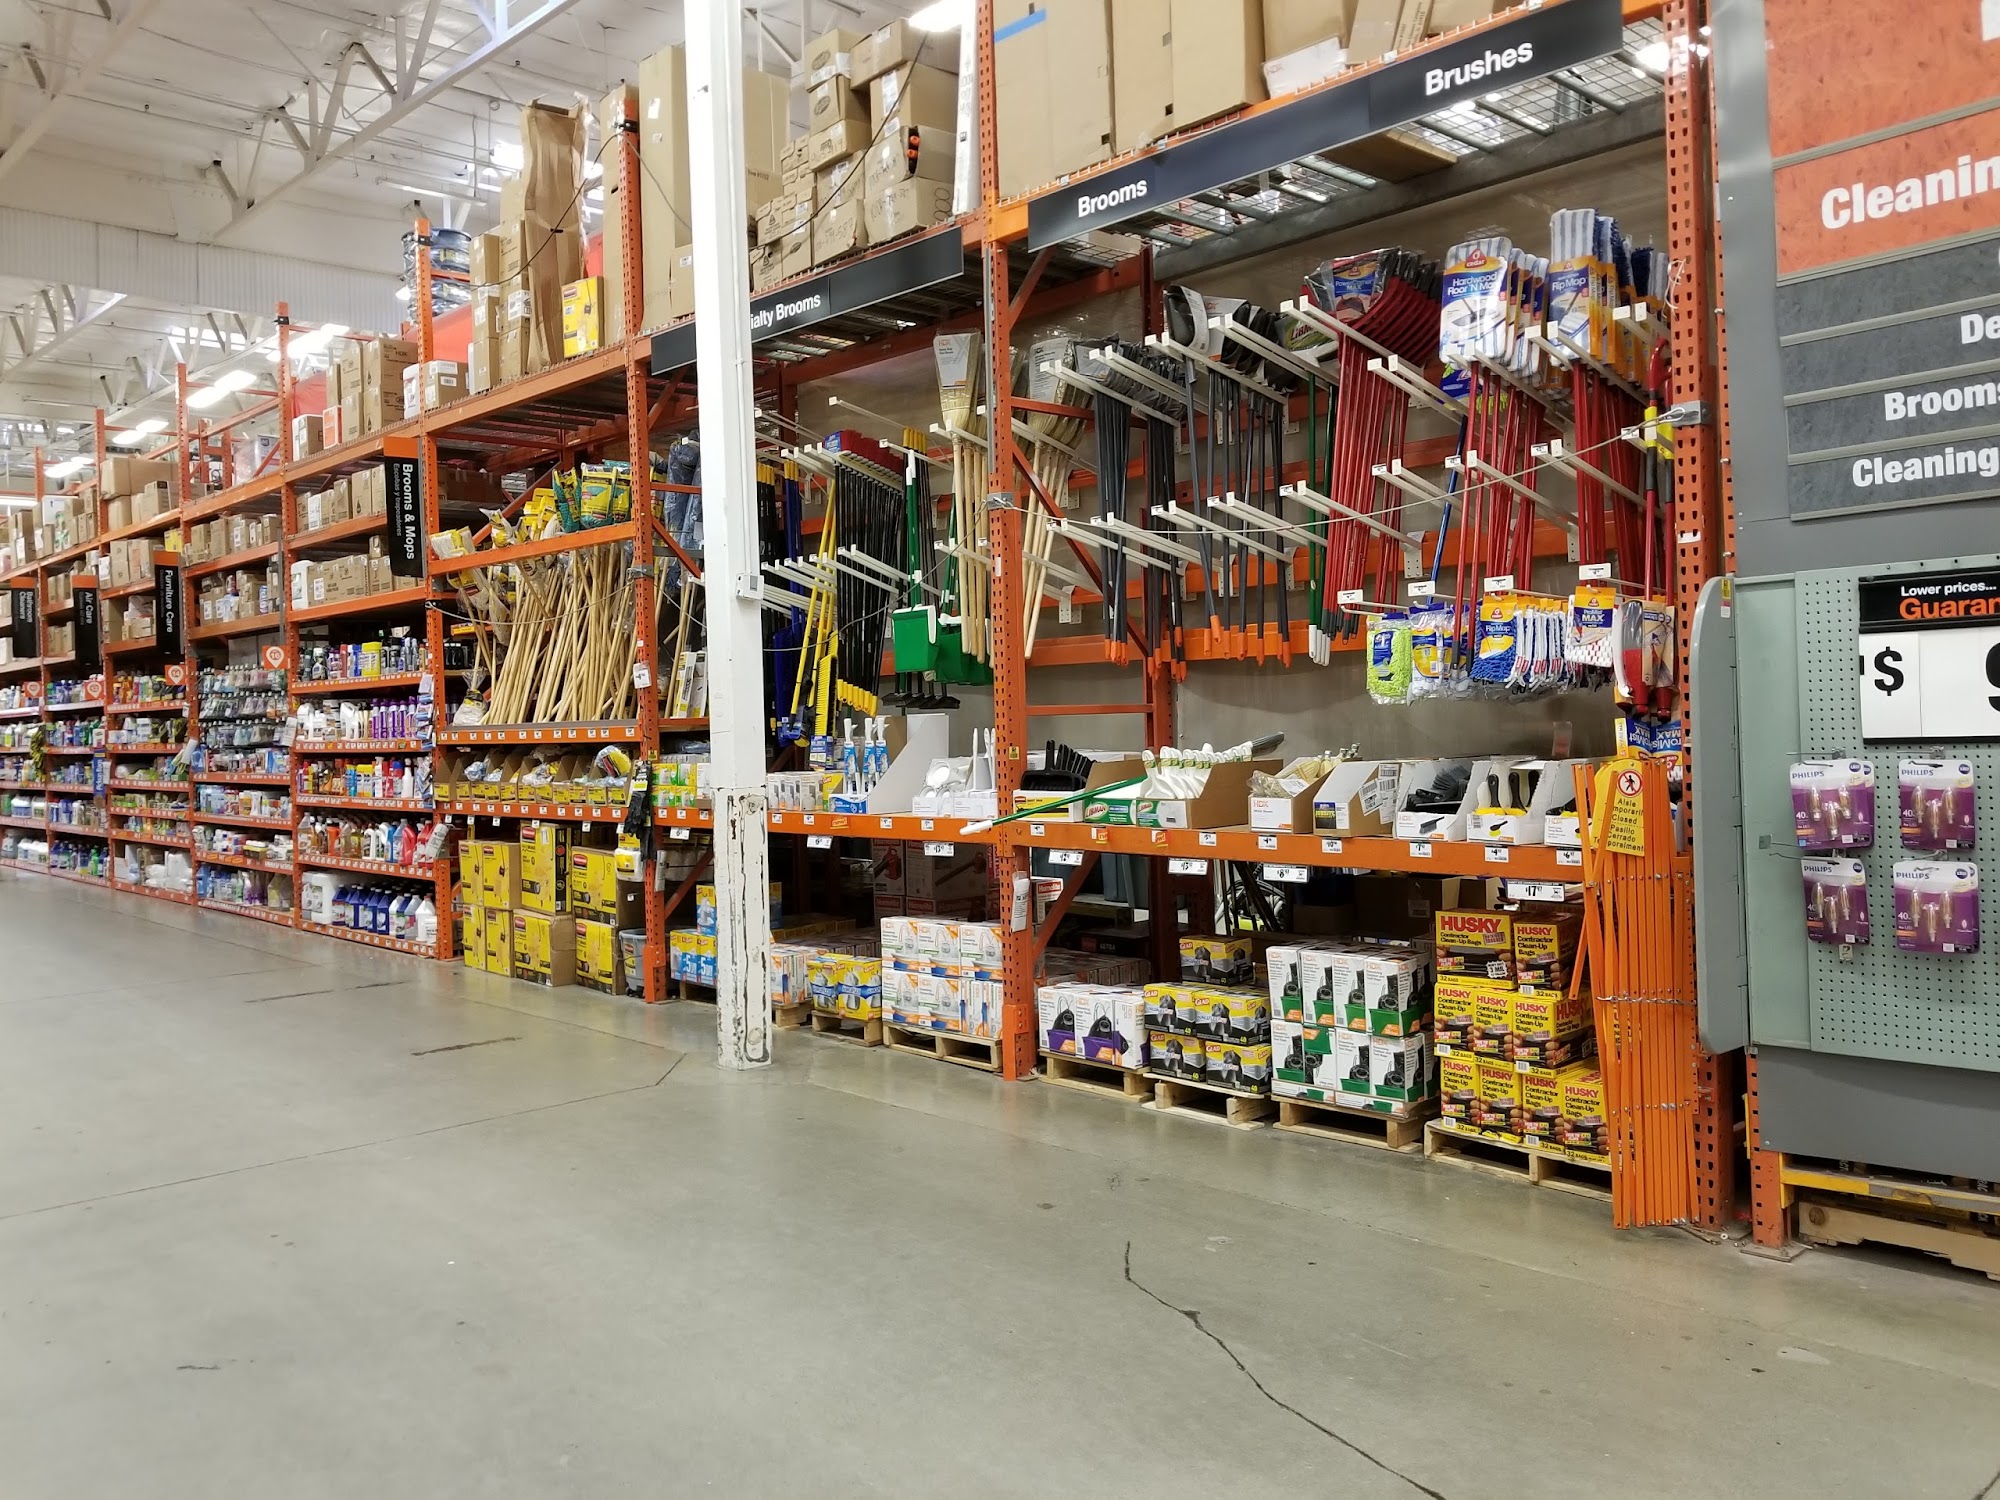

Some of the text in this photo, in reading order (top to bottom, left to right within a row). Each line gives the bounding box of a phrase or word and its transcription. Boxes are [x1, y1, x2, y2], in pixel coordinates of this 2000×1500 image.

[1425, 40, 1533, 97] Brushes
[1077, 176, 1148, 219] Brooms
[1453, 272, 1498, 287] Hardwood
[1447, 286, 1468, 296] Floor
[775, 294, 821, 321] Brooms
[1885, 382, 2000, 421] Broom
[1852, 446, 1999, 488] Cleaning
[403, 463, 416, 560] Brooms & Mops
[1901, 584, 1941, 597] Lower
[165, 570, 174, 633] Furniture Care
[85, 592, 94, 624] Air Care
[1582, 614, 1604, 622] MAX
[1874, 646, 1904, 696] $
[1656, 729, 1681, 740] MAX
[1792, 771, 1825, 779] PHILIPS
[1253, 800, 1269, 808] HDX
[1617, 798, 1637, 808] Aisle
[1085, 804, 1107, 818] LIBMAN
[1611, 813, 1638, 825] Closed
[1610, 824, 1635, 835] Pasillo
[1804, 865, 1832, 873] PHILIPS
[1896, 871, 1930, 880] PHILIPS
[1440, 916, 1501, 933] HUSKY
[1517, 926, 1552, 935] HUSKY
[1441, 937, 1467, 945] Clean-Up
[1517, 935, 1553, 943] Contractor
[1180, 942, 1193, 950] GLAD
[1438, 988, 1471, 999] HUSKY
[1195, 998, 1209, 1006] GLAD
[1438, 997, 1471, 1006] Contractor
[1476, 995, 1508, 1007] HUSKY
[1438, 1003, 1466, 1012] Clean-Up
[1476, 1005, 1508, 1015] Contractor
[1515, 1002, 1548, 1013] HUSKY
[1438, 1009, 1454, 1017] Bags
[1476, 1011, 1503, 1021] Clean-Up
[1515, 1012, 1549, 1021] Contractor
[1515, 1018, 1543, 1028] Clean-Up
[1515, 1025, 1531, 1033] Bags
[1443, 1061, 1472, 1073] HUSKY
[1443, 1070, 1473, 1080] Contractor
[1482, 1069, 1513, 1081] HUSKY
[1443, 1076, 1468, 1086] Clean-Up
[1444, 1082, 1458, 1090] Bags
[1482, 1078, 1513, 1088] Contractor
[1525, 1076, 1557, 1089] HUSKY
[1482, 1084, 1508, 1094] Clean-Up
[1525, 1086, 1558, 1097] Contractor
[1565, 1086, 1598, 1098] HUSKY
[1482, 1091, 1497, 1099] Bags
[1525, 1093, 1552, 1103] Clean-Up
[1525, 1099, 1541, 1108] Bags
[1565, 1095, 1600, 1106] Contractor
[1565, 1103, 1594, 1112] Clean-Up
[1566, 1109, 1582, 1117] Bags
